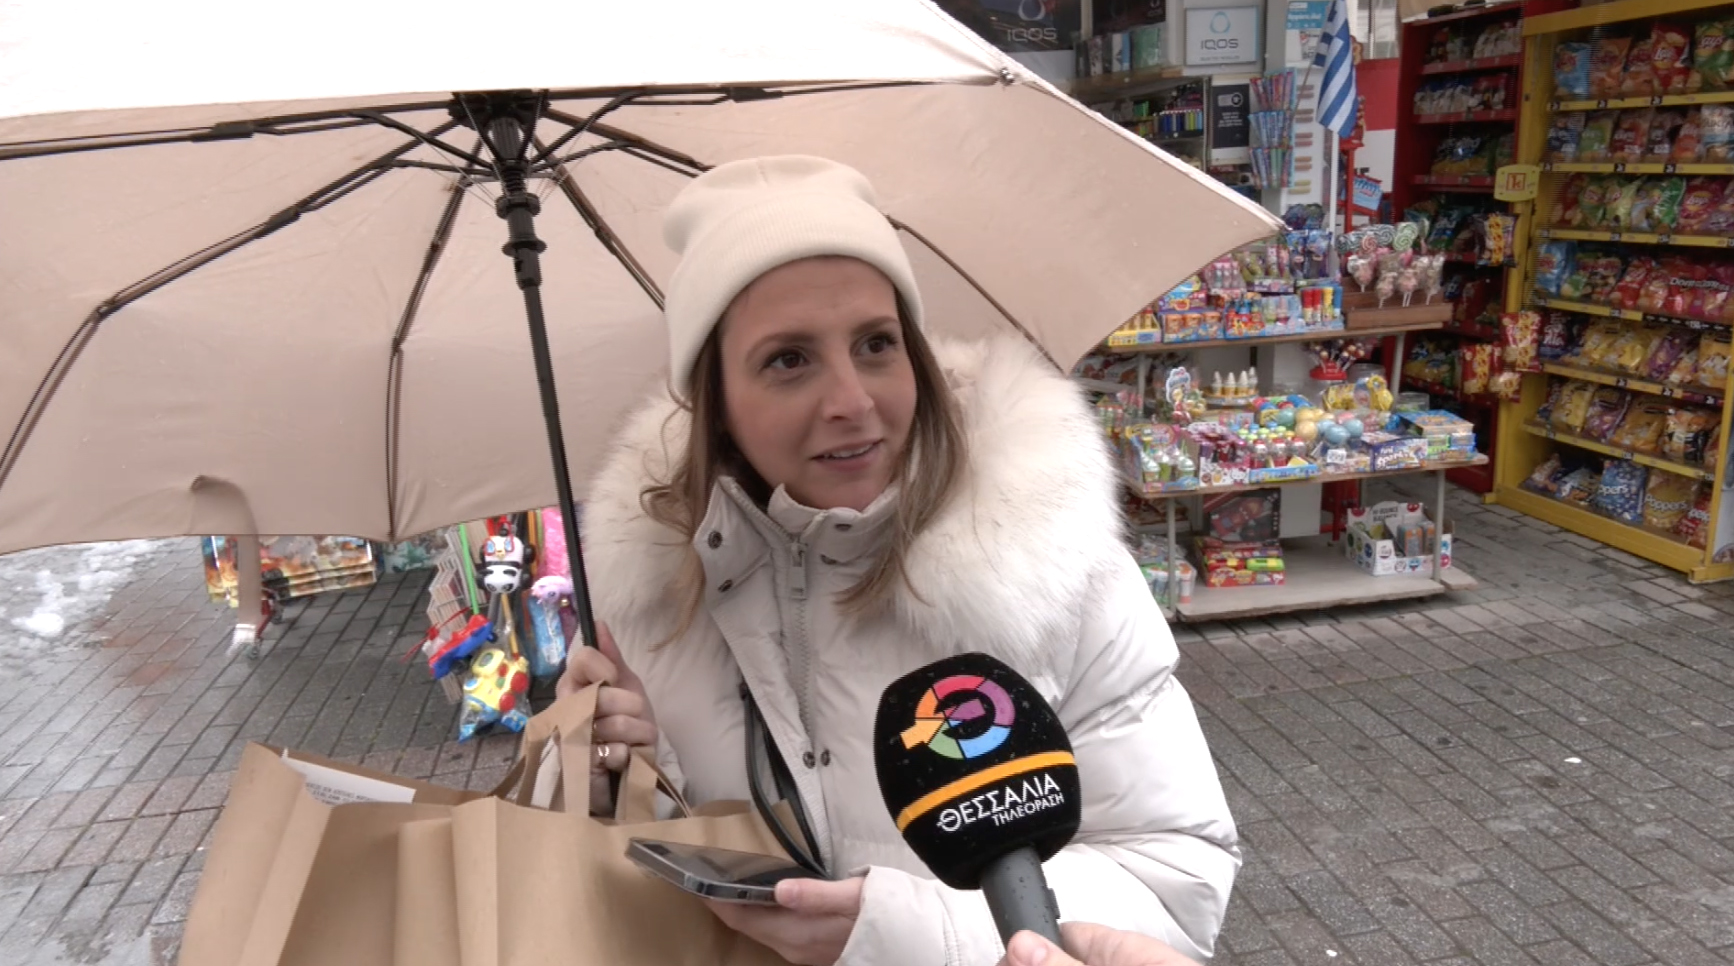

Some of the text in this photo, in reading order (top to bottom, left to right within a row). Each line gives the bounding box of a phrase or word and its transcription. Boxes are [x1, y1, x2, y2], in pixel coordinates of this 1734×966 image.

[1007, 27, 1058, 43] IQOS
[1200, 38, 1239, 51] IQOS
[937, 773, 1061, 833] ΘΕΣΣΑΛΙΑ
[991, 792, 1065, 827] ΤΗΛΕΟΡΑΣΗ
